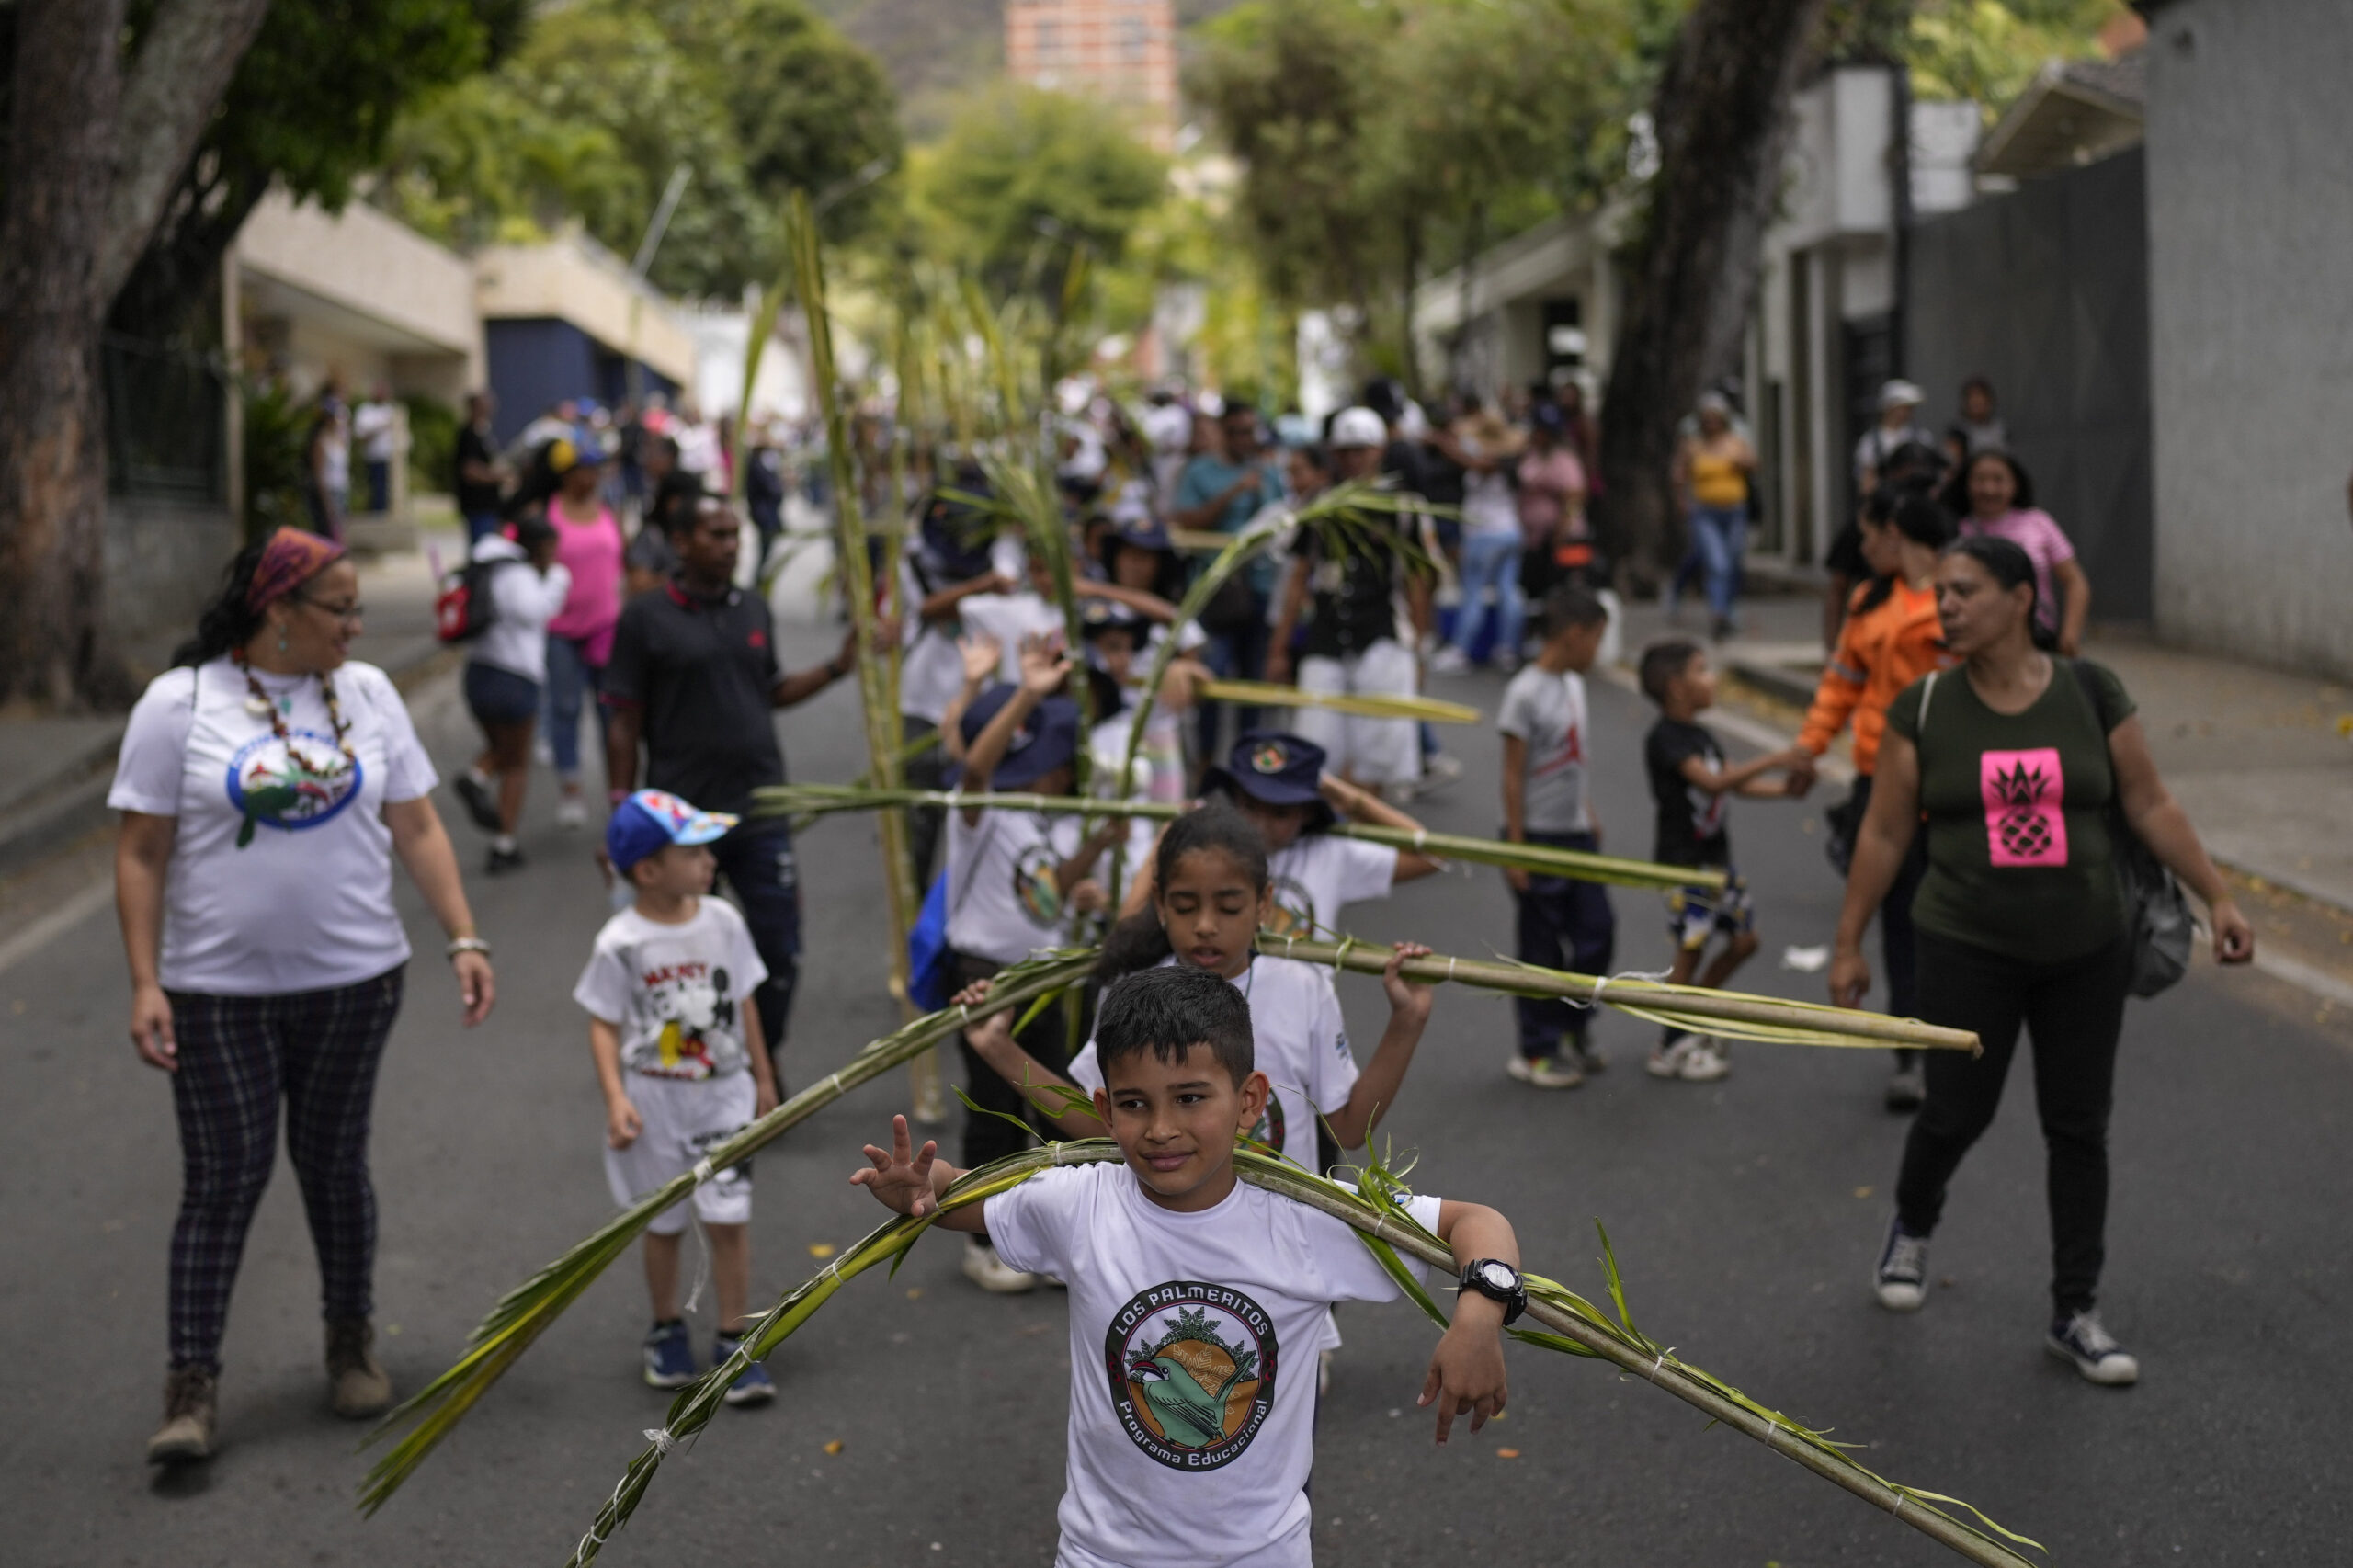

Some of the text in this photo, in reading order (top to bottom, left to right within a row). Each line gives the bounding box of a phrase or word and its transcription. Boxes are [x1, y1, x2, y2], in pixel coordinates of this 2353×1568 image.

[1115, 1286, 1268, 1336] LOS PALMERITOS
[1119, 1399, 1267, 1466] Programa Educacional
